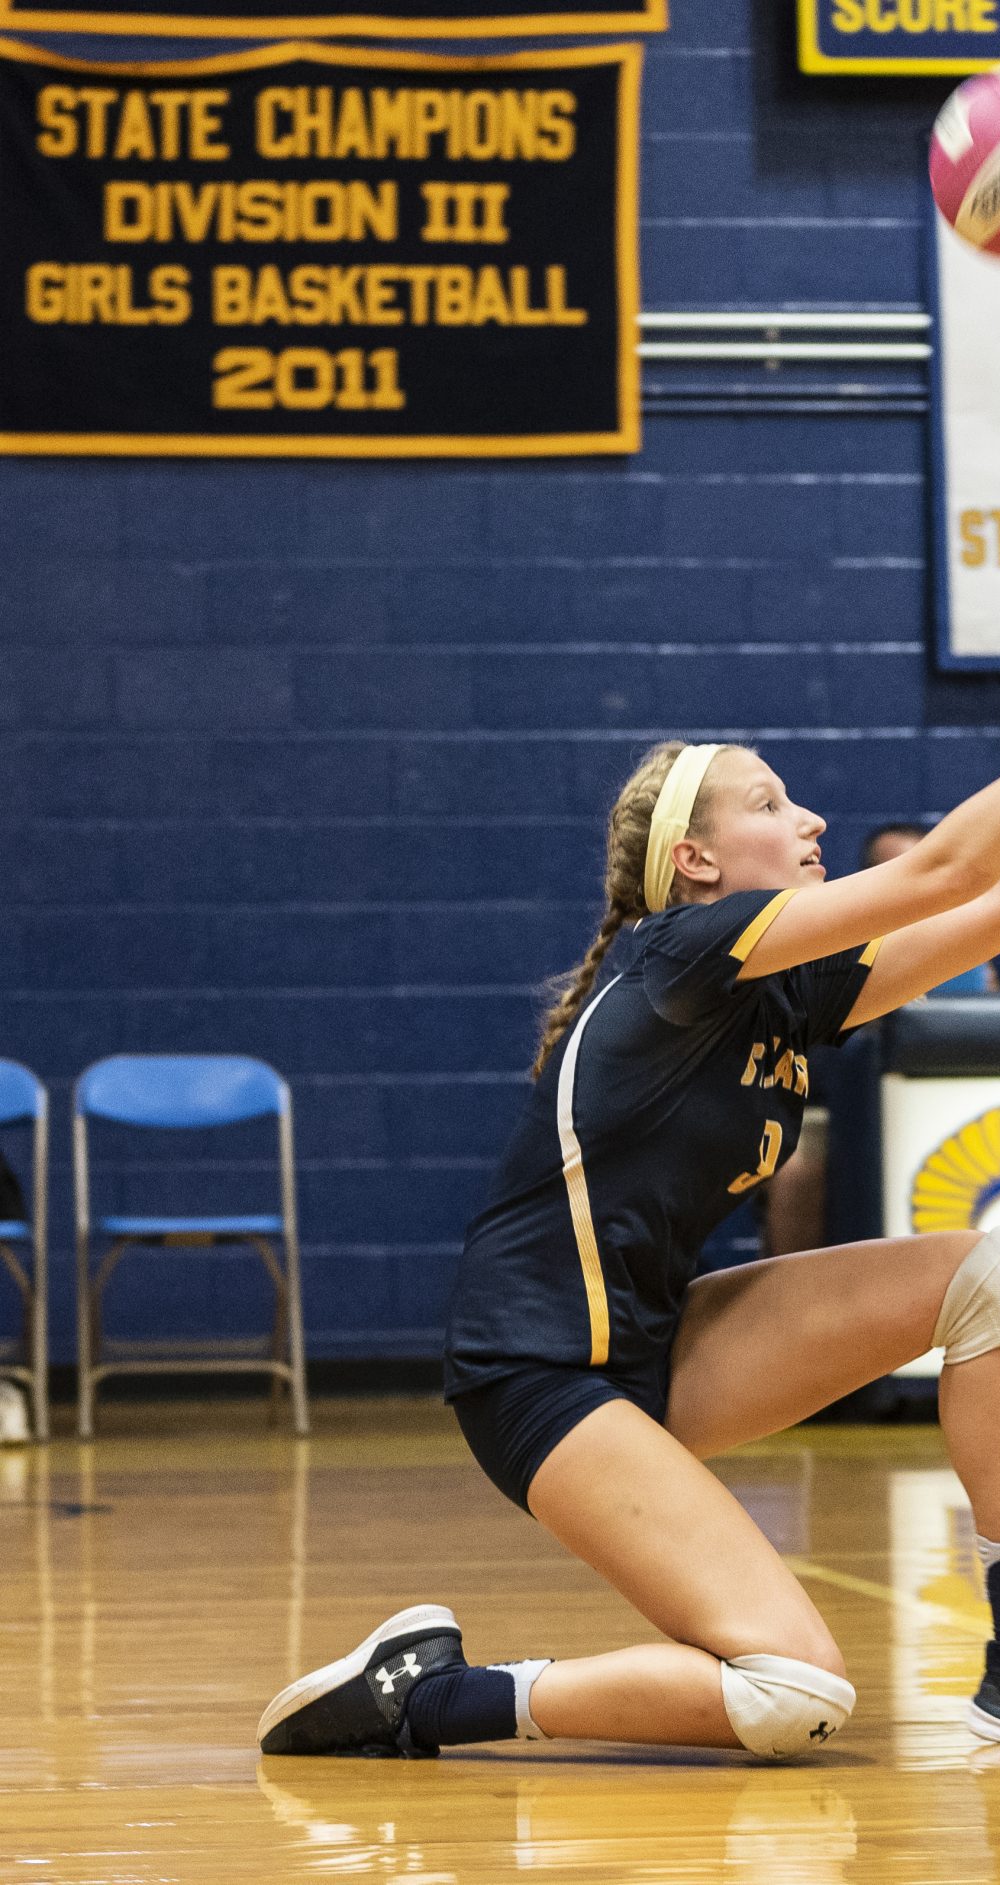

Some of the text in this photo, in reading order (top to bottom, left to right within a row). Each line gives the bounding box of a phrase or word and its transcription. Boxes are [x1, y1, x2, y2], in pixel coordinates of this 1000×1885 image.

[831, 0, 998, 33] SCORE
[37, 85, 577, 161] STATE CHAMPIONS
[104, 180, 510, 243] DIVISION III
[26, 262, 588, 325] GIRLS BASKETBALL
[212, 347, 405, 410] 2011
[727, 1118, 783, 1195] 9
